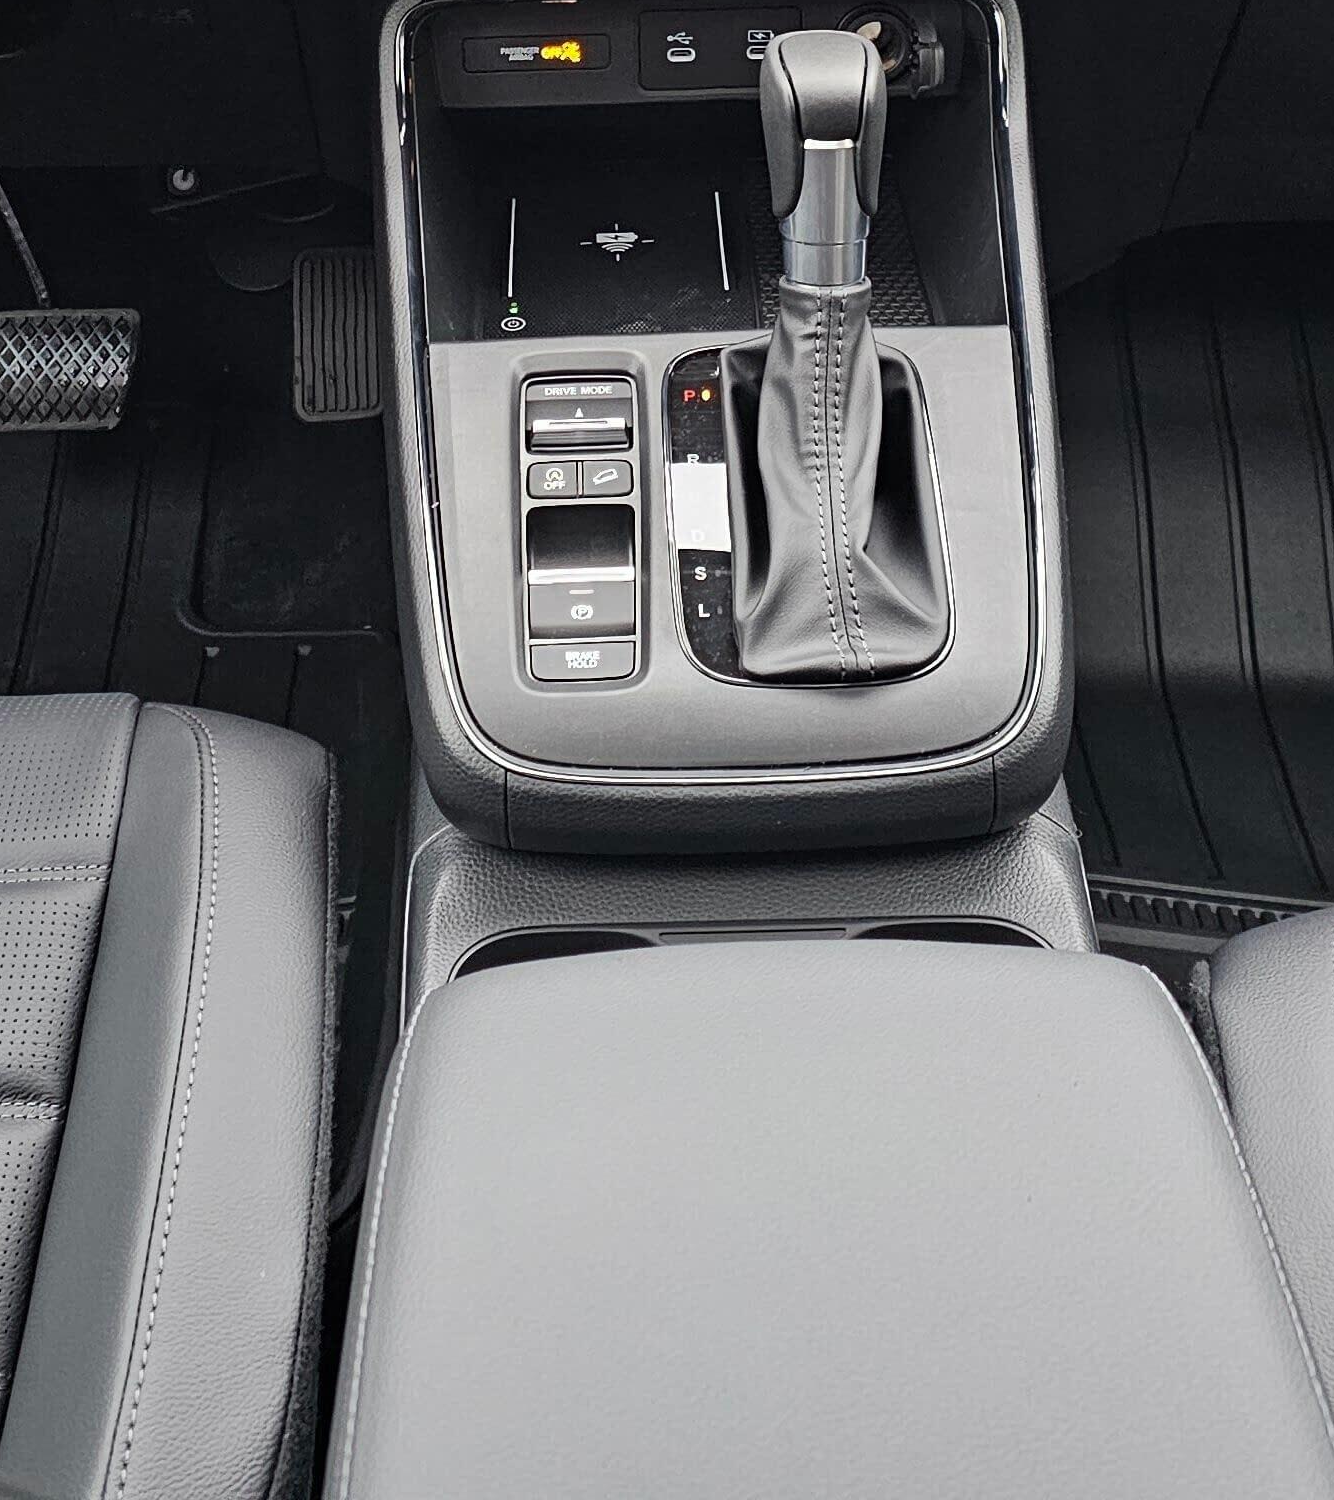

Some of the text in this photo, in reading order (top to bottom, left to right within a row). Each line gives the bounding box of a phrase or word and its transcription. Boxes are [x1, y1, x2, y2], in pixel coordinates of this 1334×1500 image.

[544, 385, 613, 396] DRIVE MODE
[683, 390, 696, 401] P
[687, 454, 700, 465] R
[543, 481, 566, 490] OFF
[694, 567, 707, 581] S
[698, 604, 710, 618] L
[565, 651, 601, 661] BRAKE
[567, 659, 598, 669] HOLD
